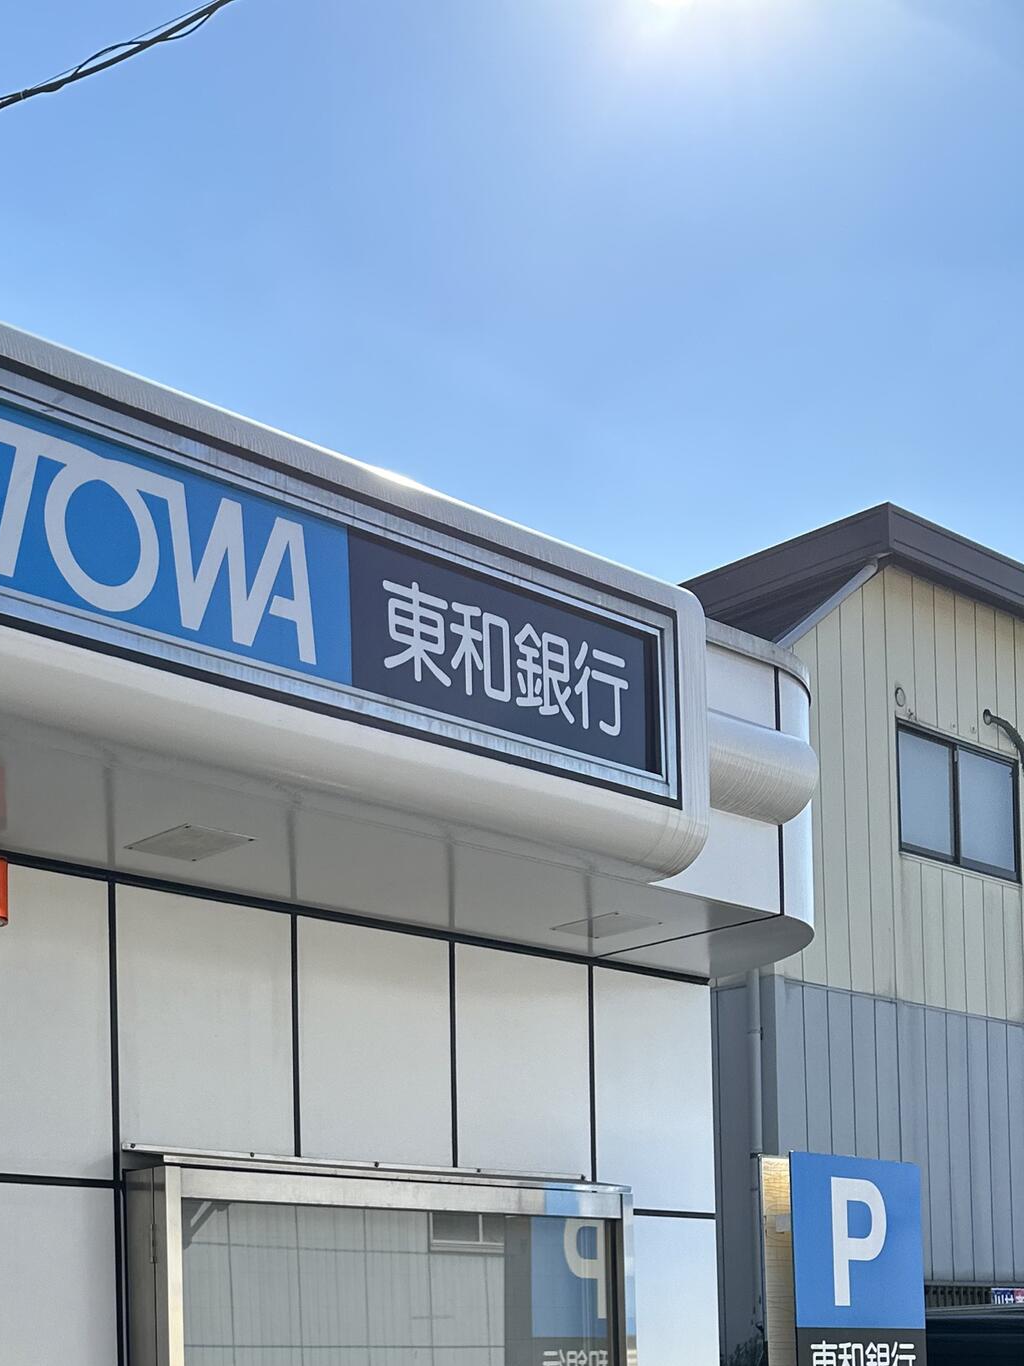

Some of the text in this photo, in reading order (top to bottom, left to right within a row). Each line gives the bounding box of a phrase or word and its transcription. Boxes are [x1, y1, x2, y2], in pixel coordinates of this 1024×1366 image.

[381, 578, 630, 738] 東和銀行
[831, 1176, 888, 1307] P
